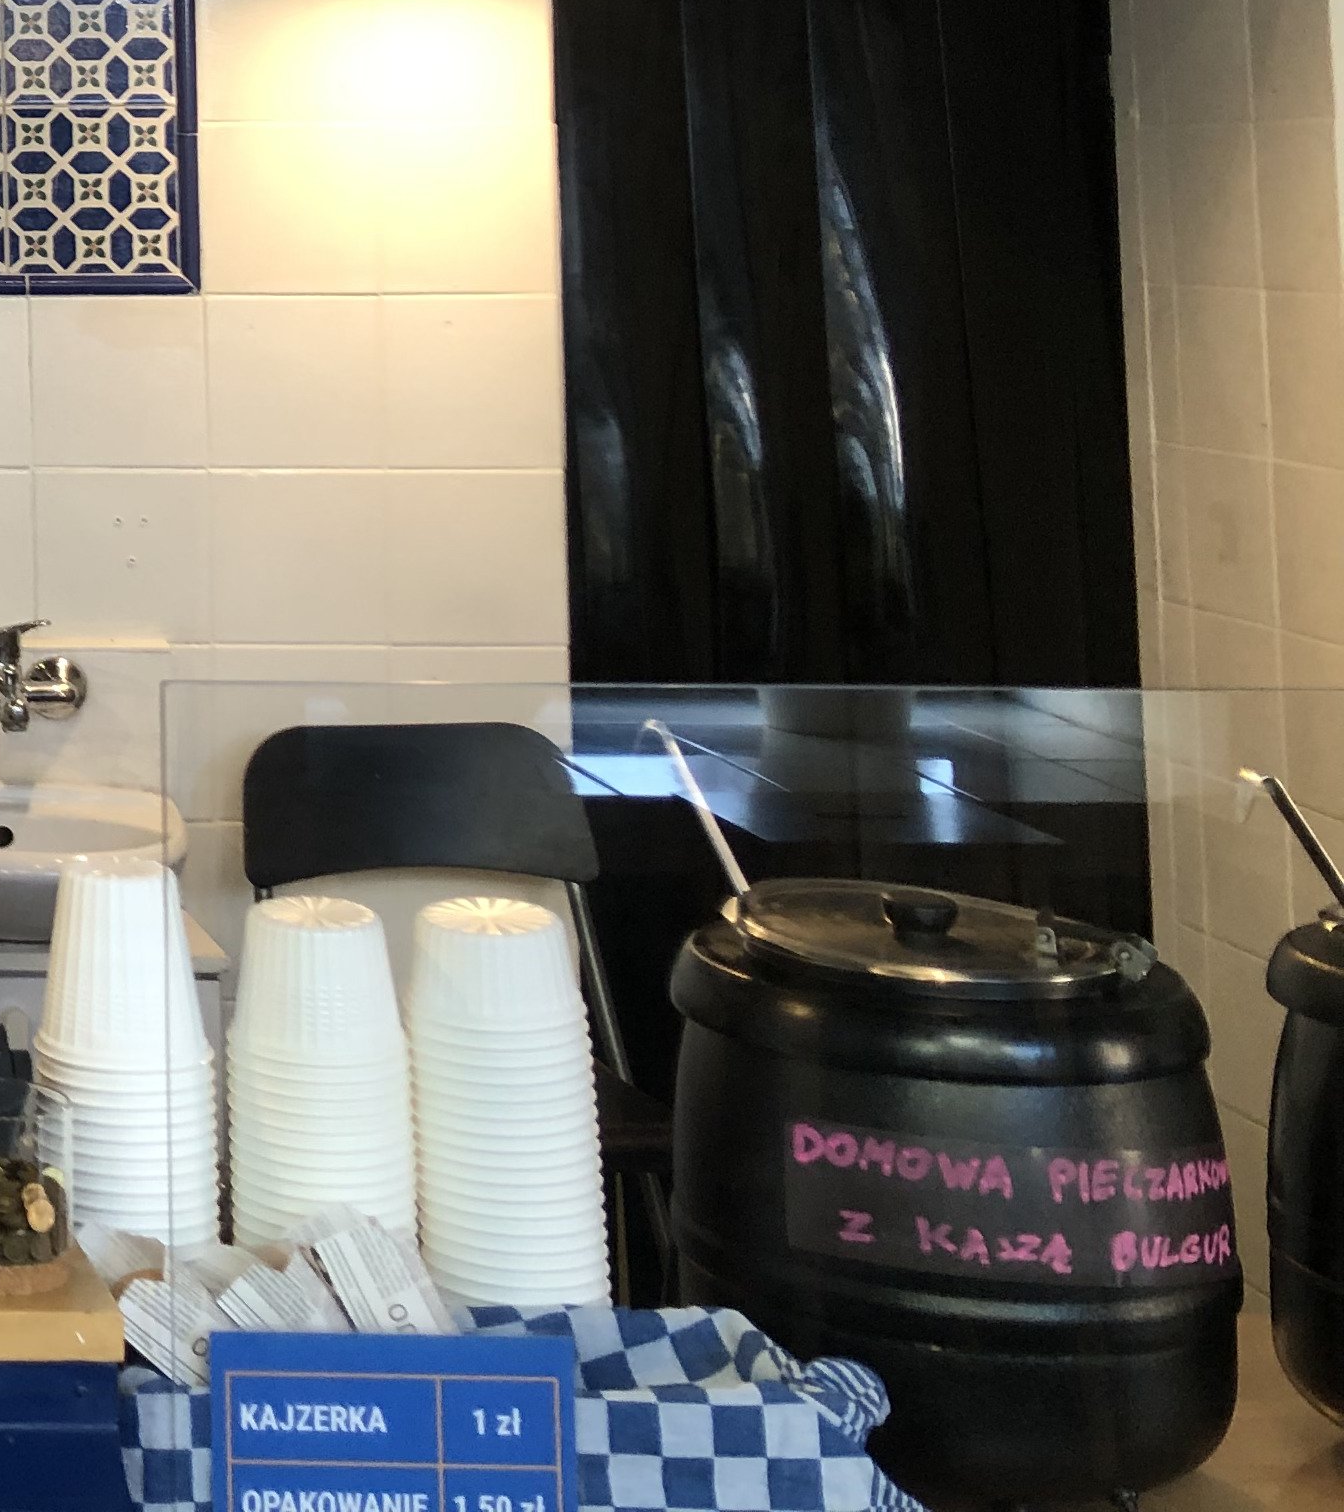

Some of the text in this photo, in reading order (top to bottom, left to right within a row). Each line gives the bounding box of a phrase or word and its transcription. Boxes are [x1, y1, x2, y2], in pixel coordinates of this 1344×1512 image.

[791, 1122, 1013, 1201] DOMOWA
[838, 1209, 875, 1245] Z
[1110, 1223, 1232, 1272] BULGUR
[239, 1402, 522, 1438] KAJZERKA 1 zł
